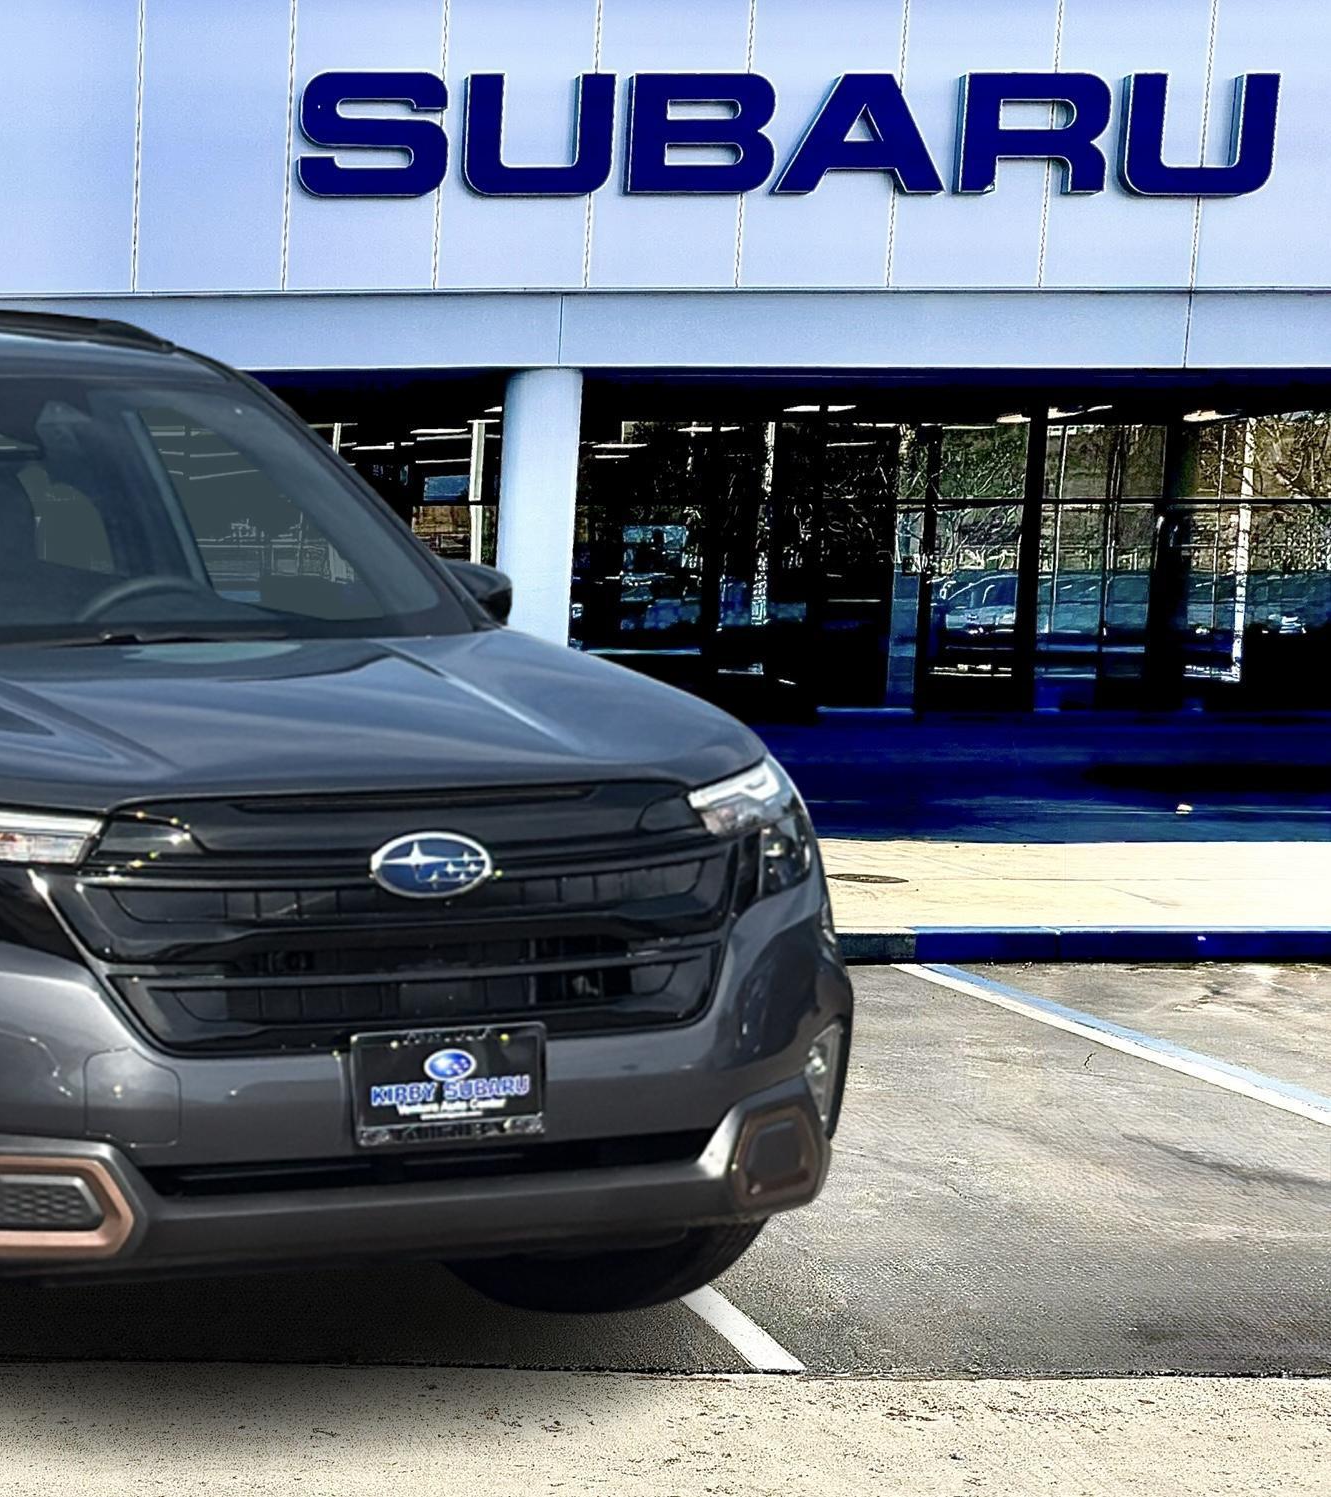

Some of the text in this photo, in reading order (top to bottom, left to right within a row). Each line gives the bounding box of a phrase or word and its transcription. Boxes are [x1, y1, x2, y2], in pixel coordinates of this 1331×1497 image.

[298, 70, 1283, 198] SUBARU
[371, 1075, 530, 1106] KIRBY SUBARU
